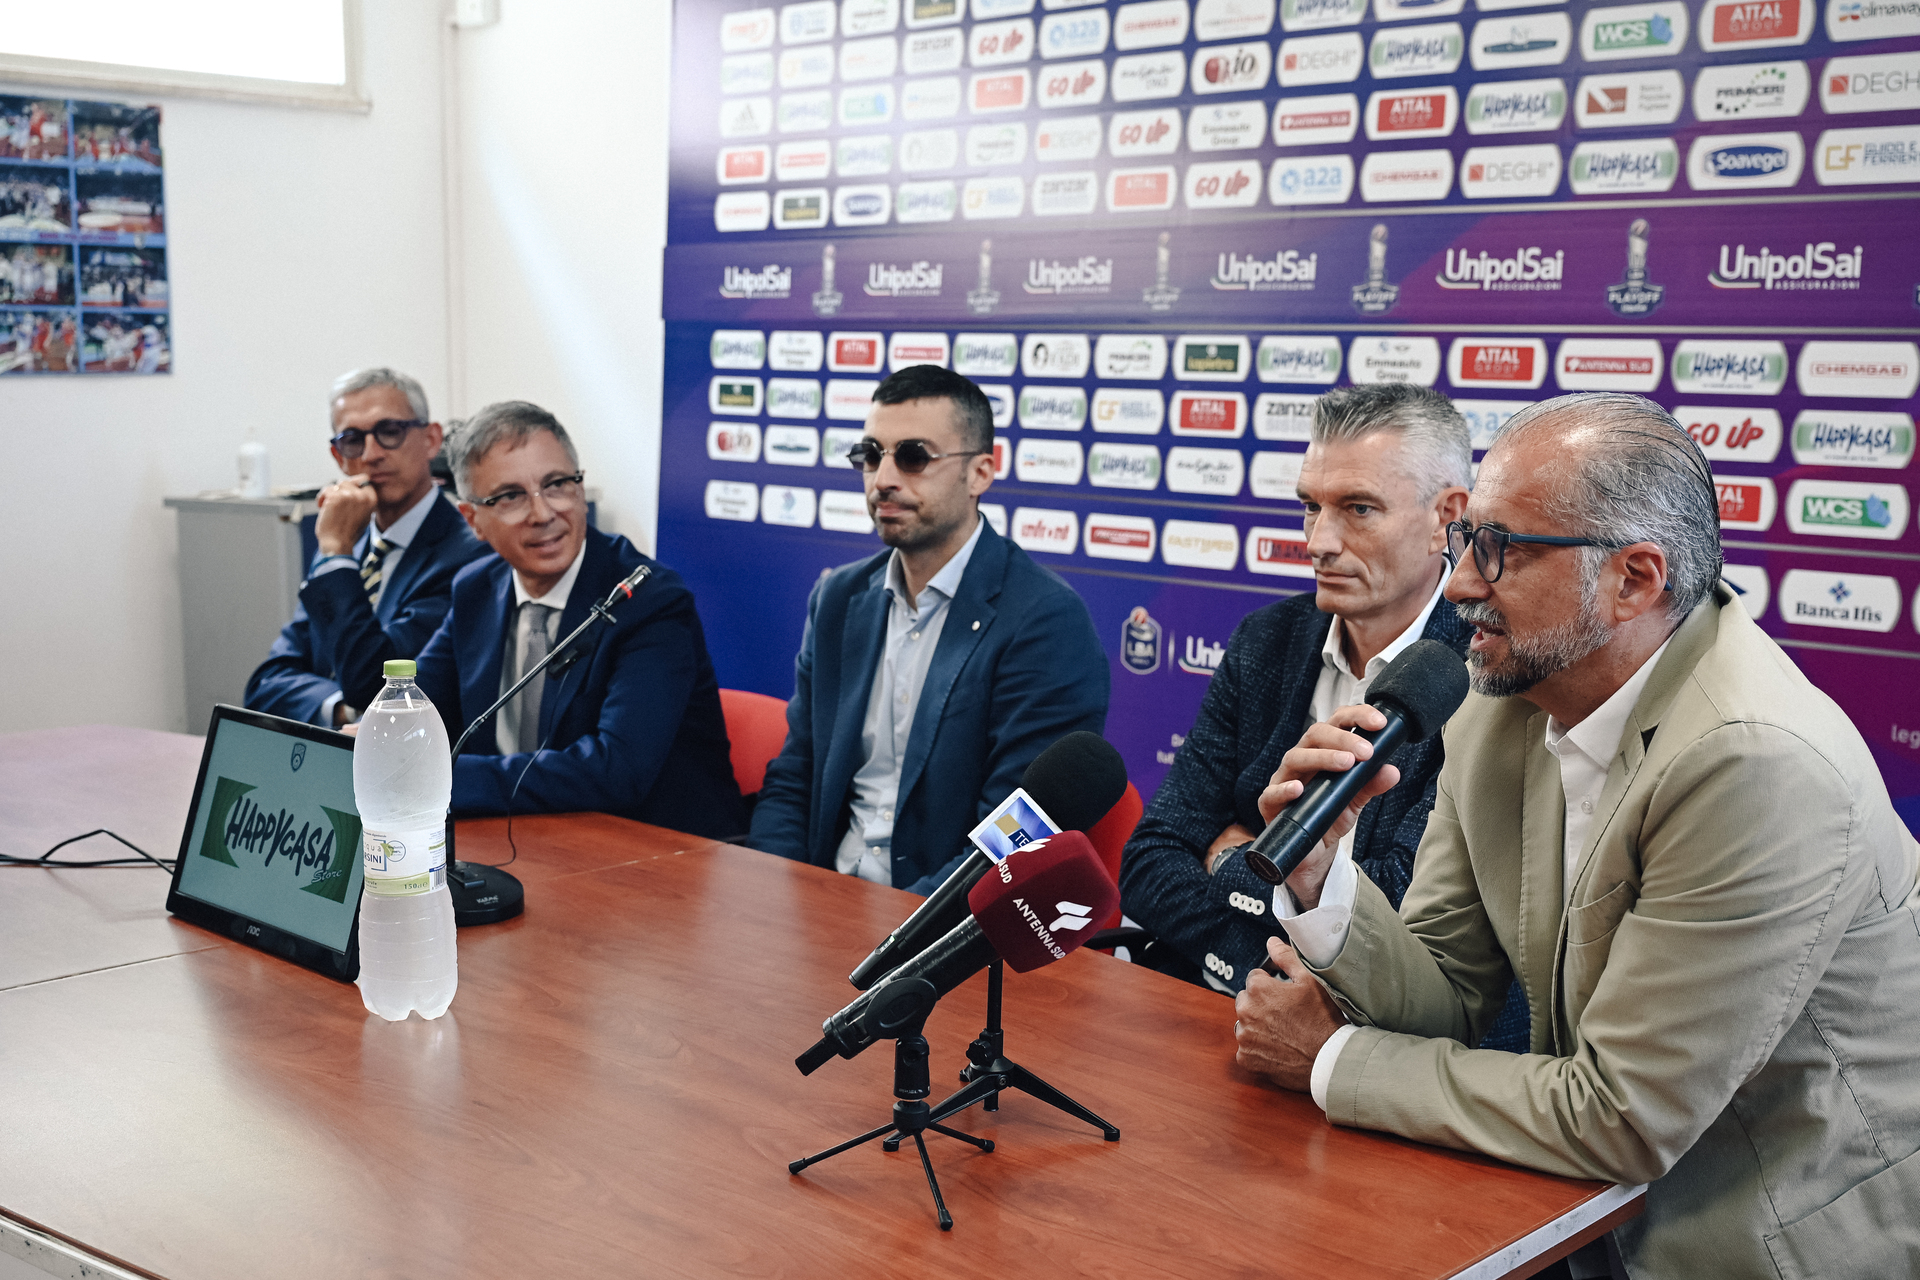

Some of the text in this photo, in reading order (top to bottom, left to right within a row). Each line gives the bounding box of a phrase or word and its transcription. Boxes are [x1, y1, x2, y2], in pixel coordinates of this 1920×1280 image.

[1731, 3, 1783, 22] ATTAL
[1597, 21, 1649, 43] WCS
[1729, 18, 1783, 34] GROUP
[1047, 76, 1069, 97] GO
[1391, 97, 1433, 115] ATTAL
[1118, 124, 1142, 146] GO
[1486, 161, 1546, 182] DEGHI
[1715, 151, 1787, 173] Soavegel
[1195, 169, 1250, 197] GO UP
[1302, 166, 1342, 187] a2a
[1028, 256, 1113, 295] UnipolSai
[1218, 250, 1318, 291] UnipolSai
[1445, 246, 1565, 291] UnipolSai
[1718, 241, 1863, 290] UnipolSai
[724, 264, 792, 299] UnipolSai
[868, 260, 943, 297] UnipolSai
[1774, 279, 1861, 290] ASSICURAZIONI
[1607, 290, 1662, 305] PLAYOFF
[1474, 348, 1520, 364] ATTAL
[1474, 362, 1520, 374] GROUP
[1267, 402, 1314, 417] zanza
[1686, 417, 1764, 449] GO UP
[1716, 486, 1745, 504] TAL
[1805, 498, 1864, 521] WCS
[1796, 602, 1883, 623] Banca Ifis
[310, 868, 343, 884] Store
